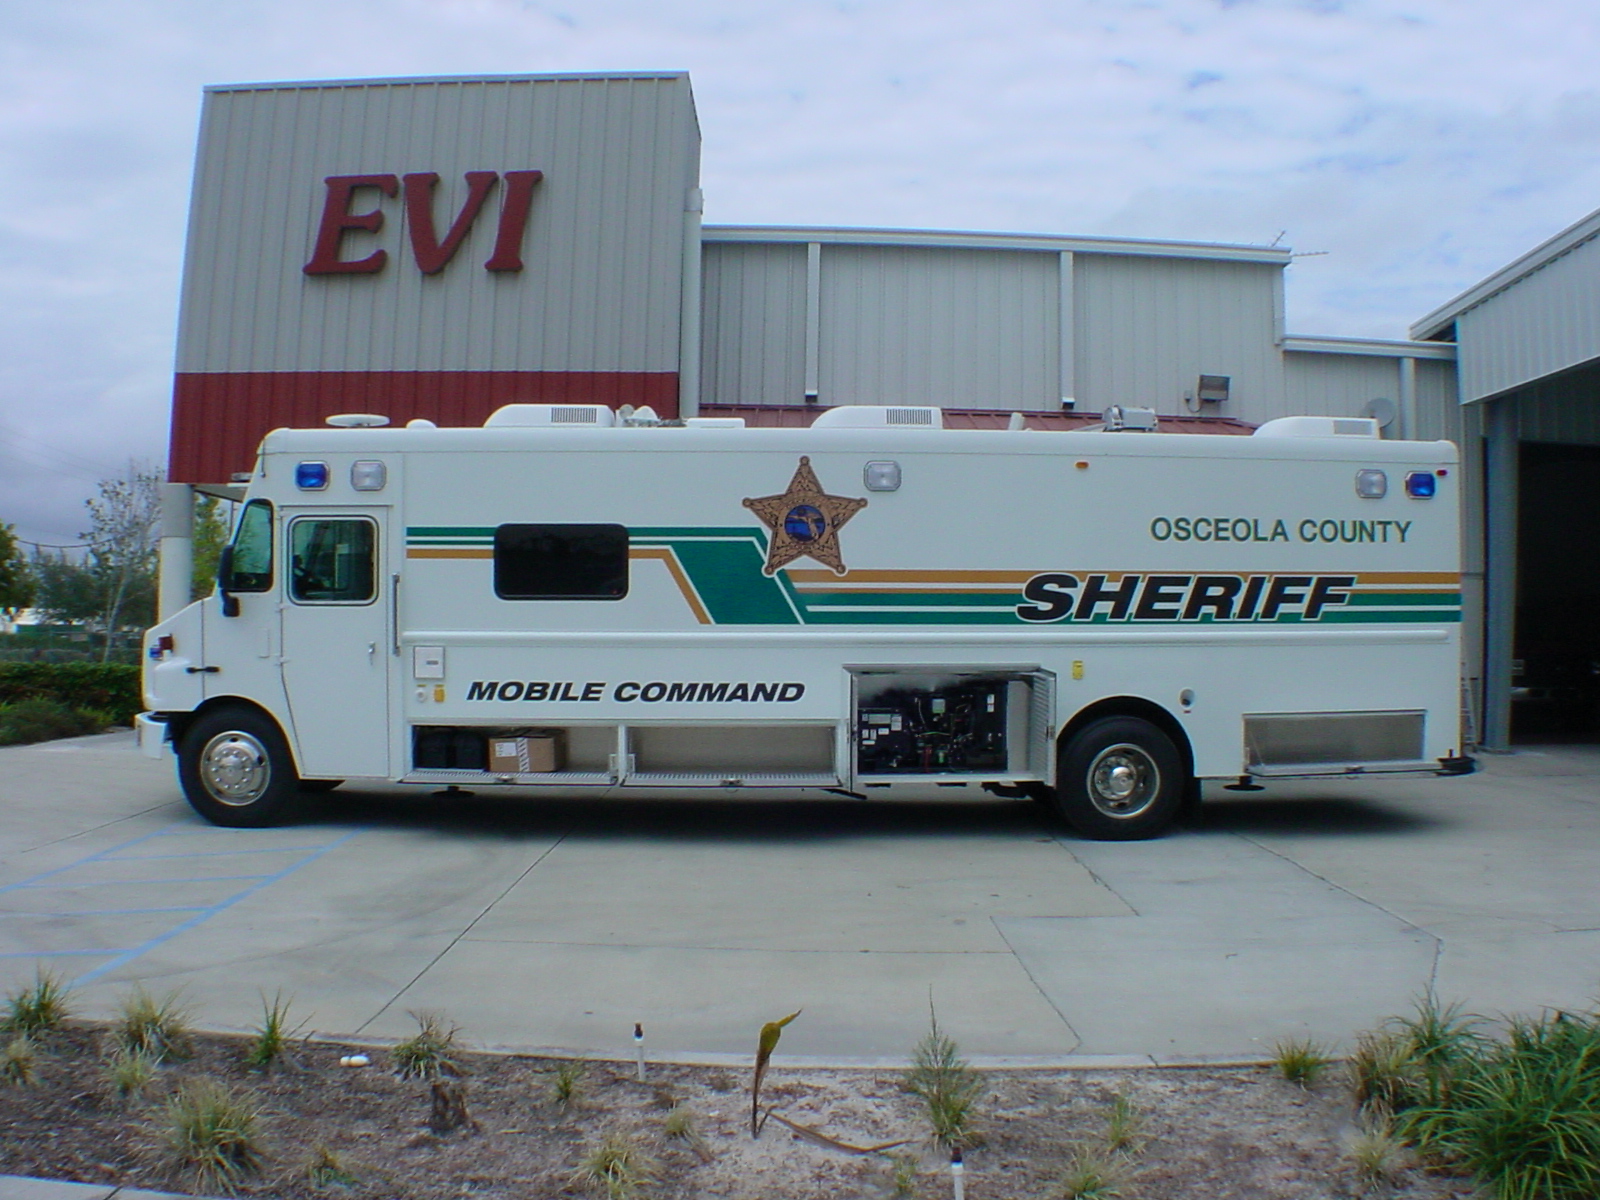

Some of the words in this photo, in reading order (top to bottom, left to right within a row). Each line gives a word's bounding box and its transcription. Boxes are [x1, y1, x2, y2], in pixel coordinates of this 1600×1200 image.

[303, 170, 543, 275] EVI
[1151, 517, 1289, 542] OSCEOLA
[1299, 519, 1412, 543] COUNTY
[1016, 572, 1358, 622] SHERIFF
[466, 681, 606, 702] MOBILE
[613, 681, 806, 703] COMMAND
